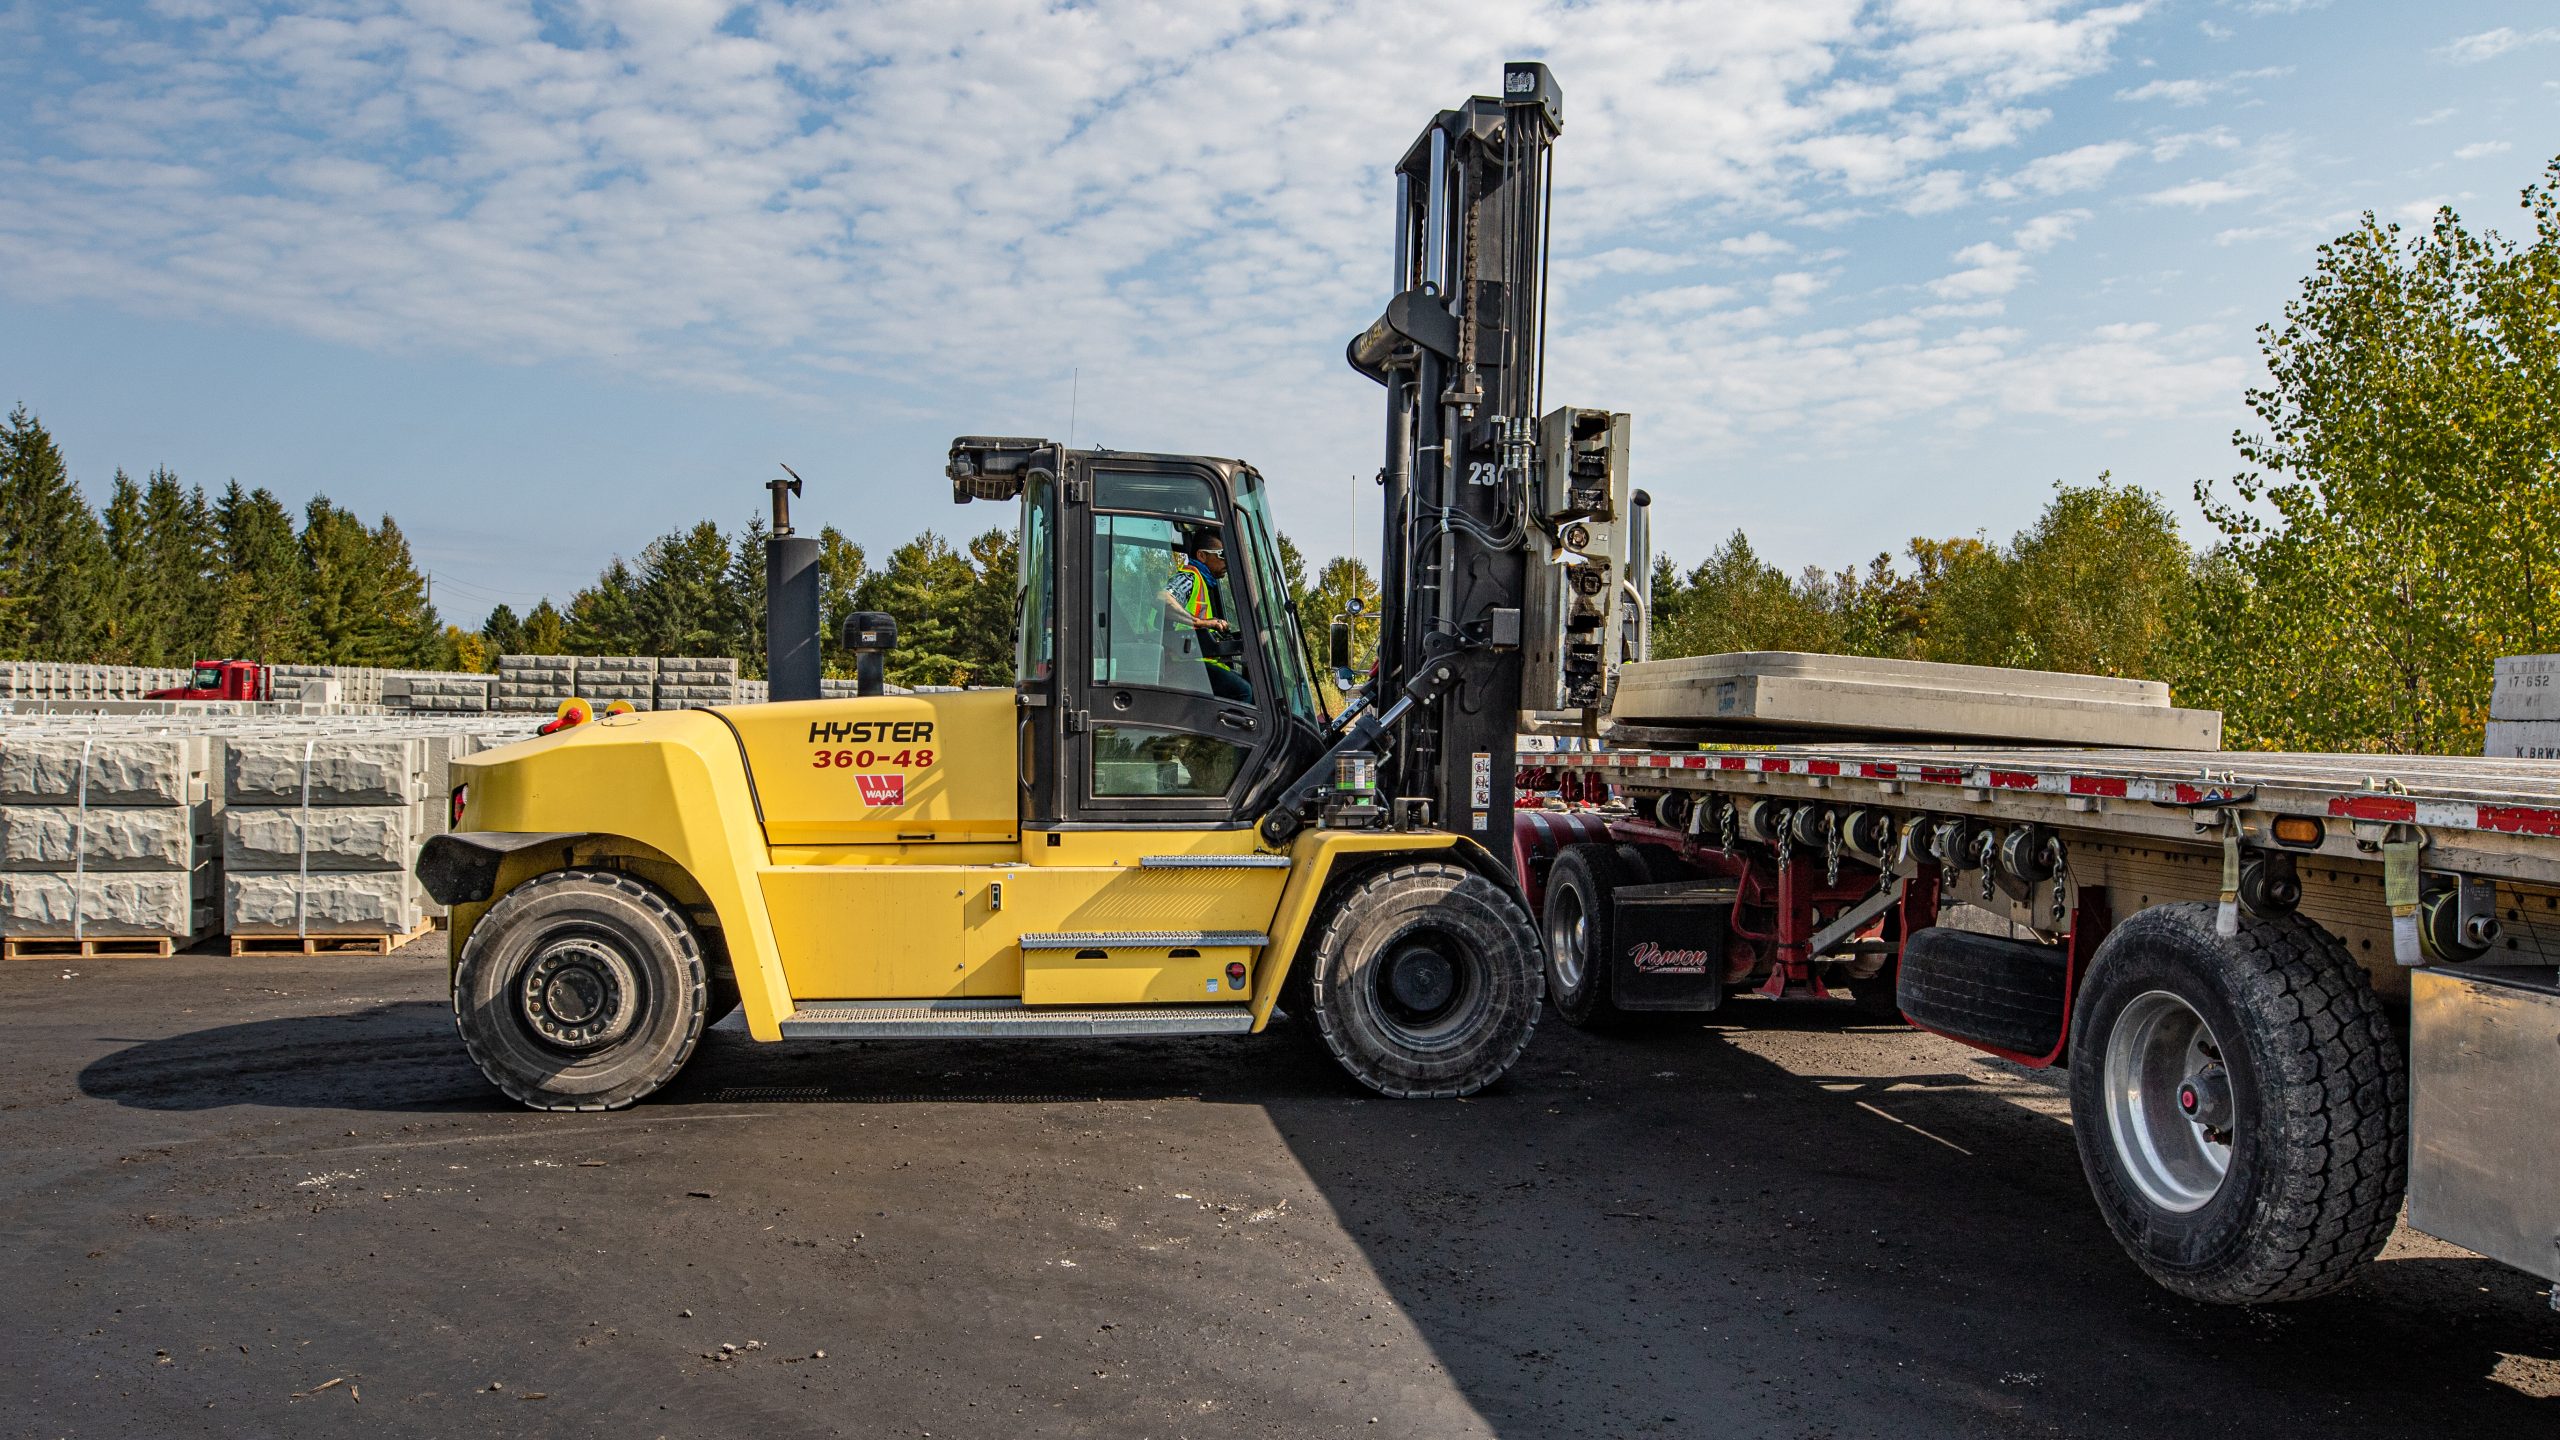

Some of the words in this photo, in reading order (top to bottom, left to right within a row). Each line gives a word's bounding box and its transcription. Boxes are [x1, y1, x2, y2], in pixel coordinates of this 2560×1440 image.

[808, 721, 934, 743] HYSTER
[812, 749, 934, 769] 360-48
[865, 789, 898, 800] WAJAX
[1628, 941, 1708, 967] Vanson
